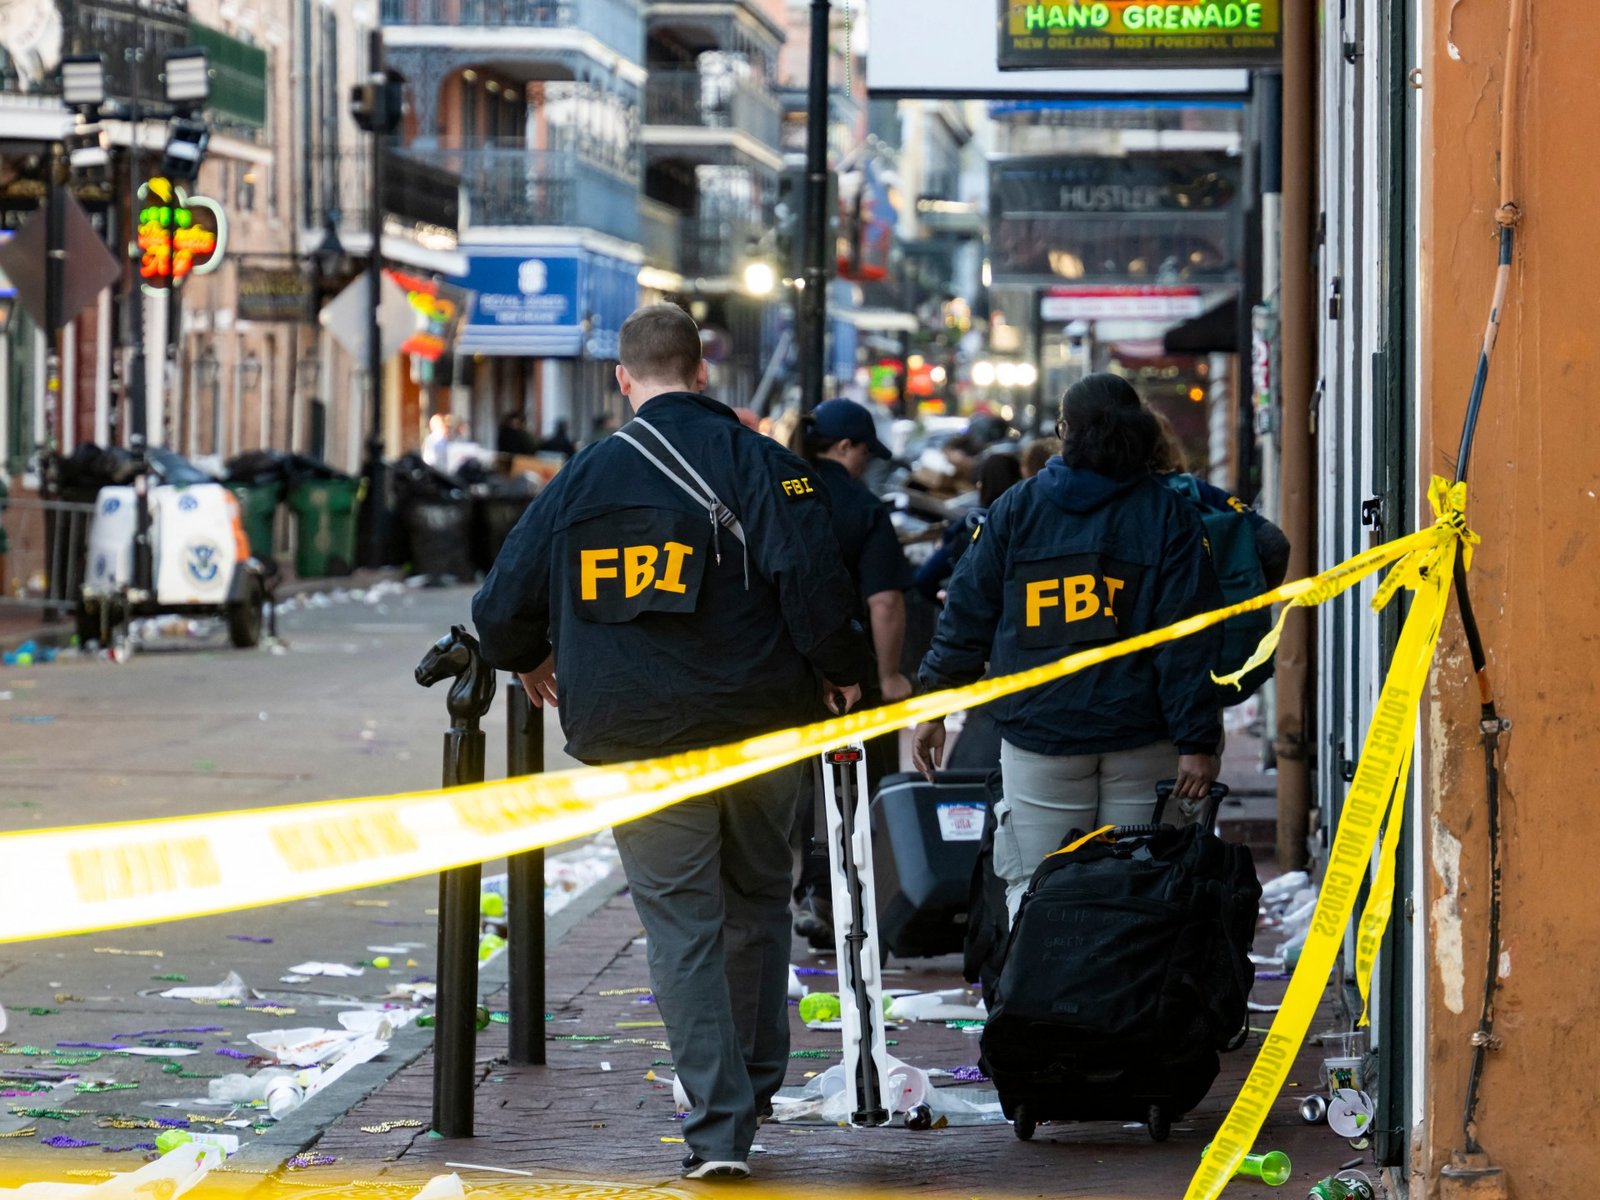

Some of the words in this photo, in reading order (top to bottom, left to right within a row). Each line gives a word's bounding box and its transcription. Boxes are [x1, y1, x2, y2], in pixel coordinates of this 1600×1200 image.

[1026, 3, 1110, 30] HAND
[1122, 2, 1262, 30] GRENADE
[1013, 37, 1043, 49] NEW
[1047, 37, 1111, 49] ORLEANS
[1114, 37, 1151, 49] MOST
[1154, 36, 1229, 49] POWERFUL
[1232, 37, 1276, 49] DRINK
[1060, 184, 1158, 211] HUSTLER
[781, 477, 814, 497] FBI
[581, 541, 694, 600] FBI
[1026, 574, 1125, 627] FBI
